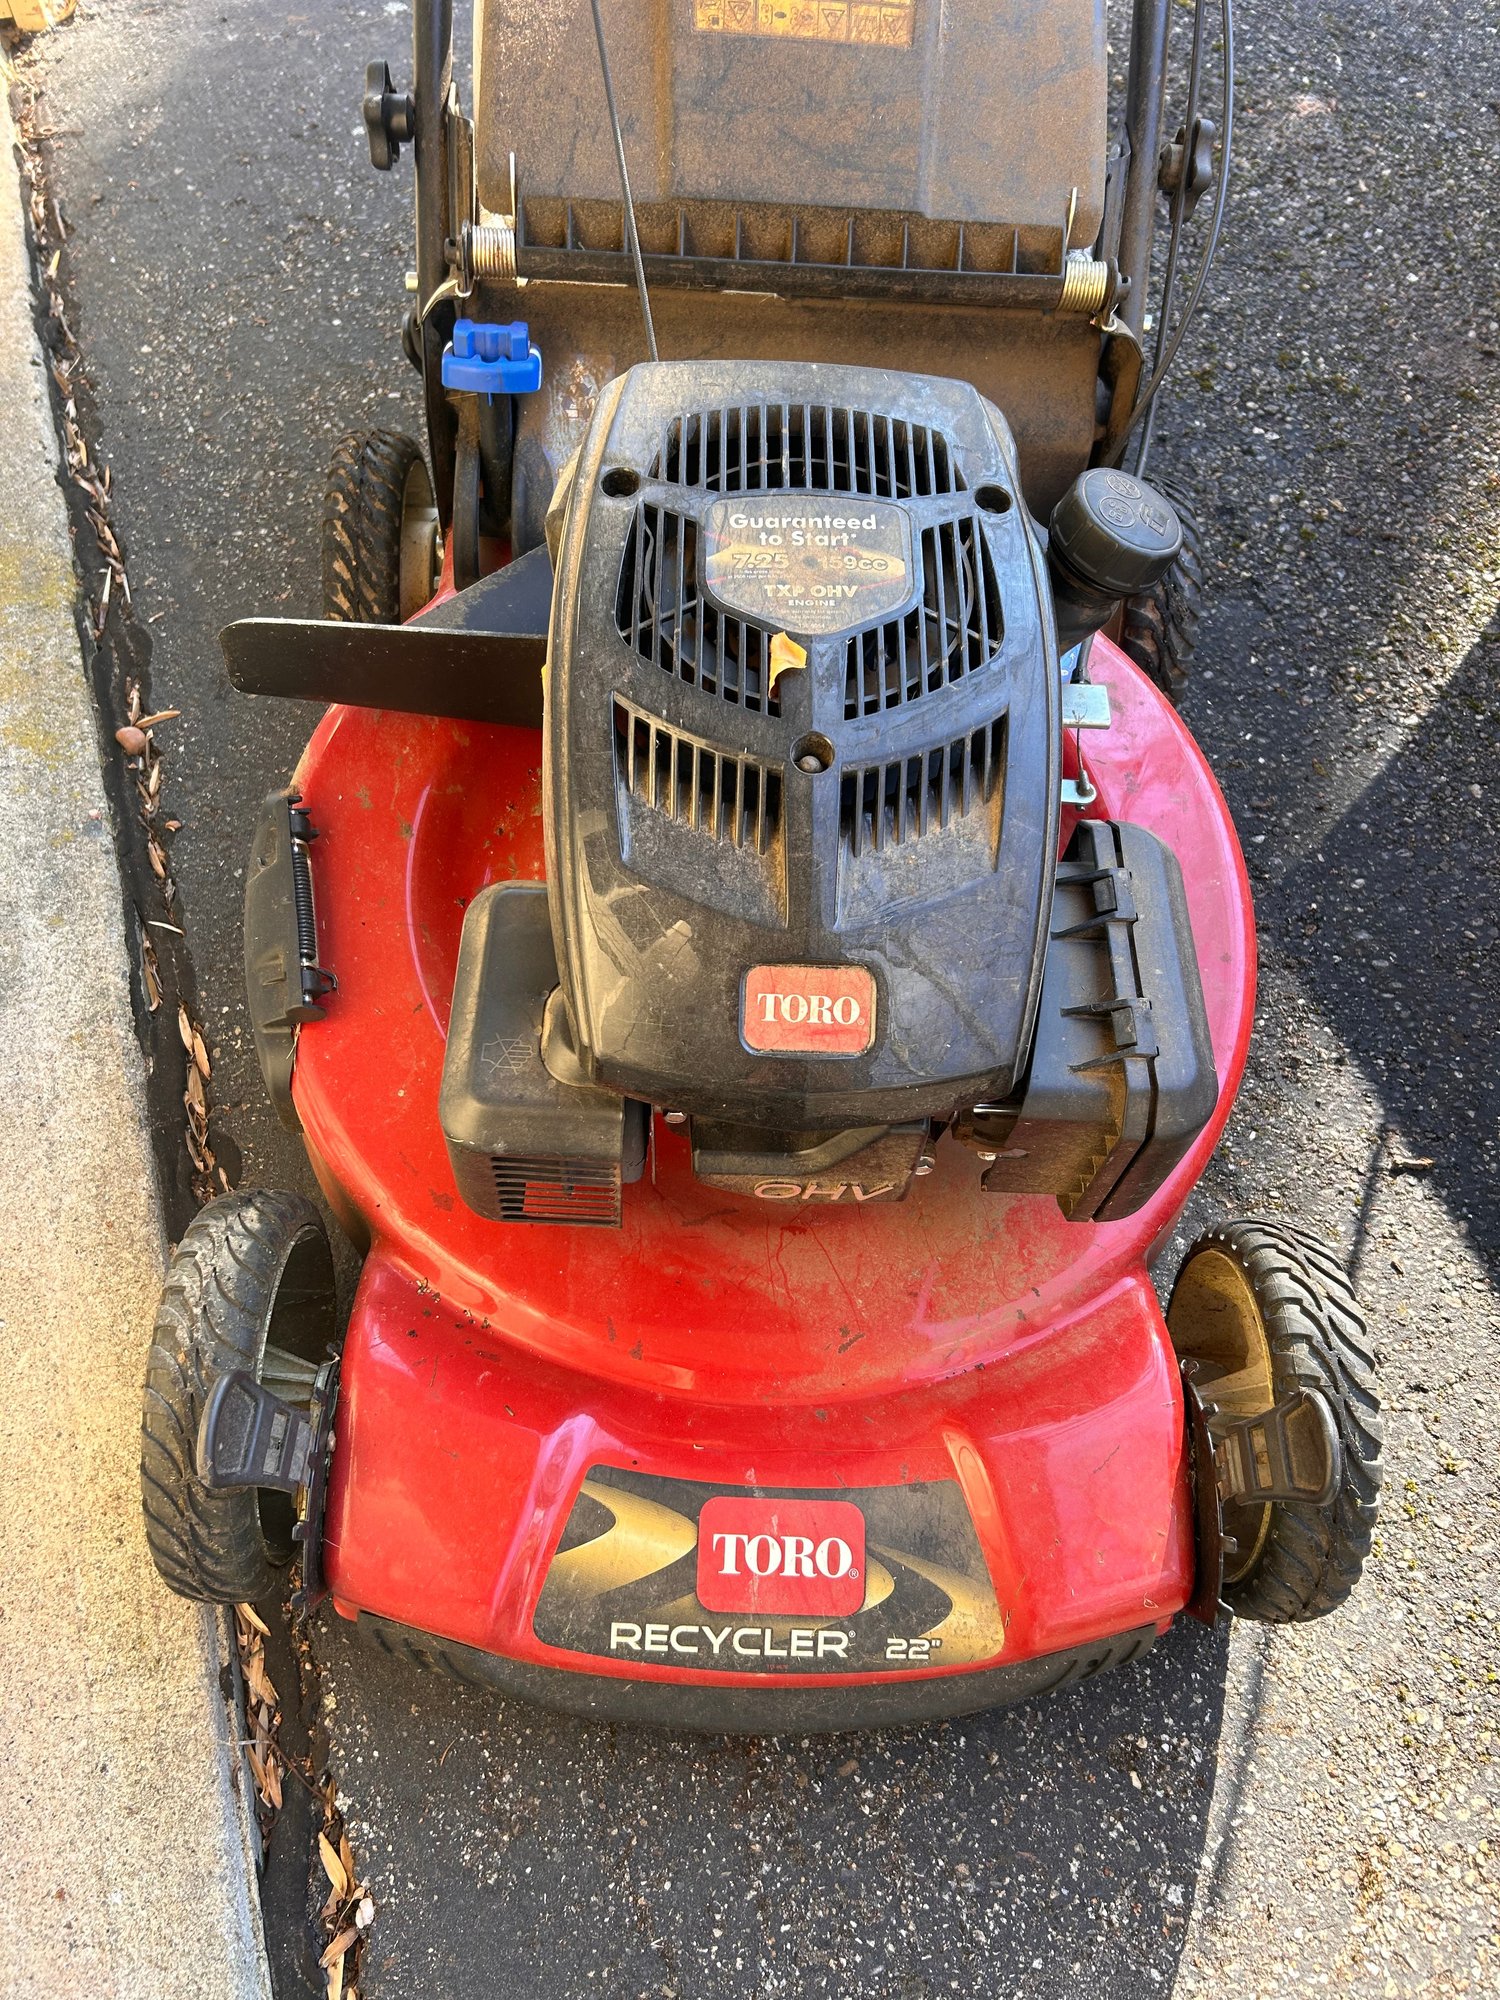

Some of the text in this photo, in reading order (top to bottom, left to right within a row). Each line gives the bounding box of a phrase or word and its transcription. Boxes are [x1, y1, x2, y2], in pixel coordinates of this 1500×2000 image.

[729, 513, 877, 530] Guaranteed
[759, 532, 782, 546] to
[732, 553, 790, 569] 7.25
[764, 584, 858, 598] TXP OHV
[788, 599, 836, 607] ENGINE
[754, 1178, 894, 1201] OHV
[884, 1637, 943, 1661] 22"
